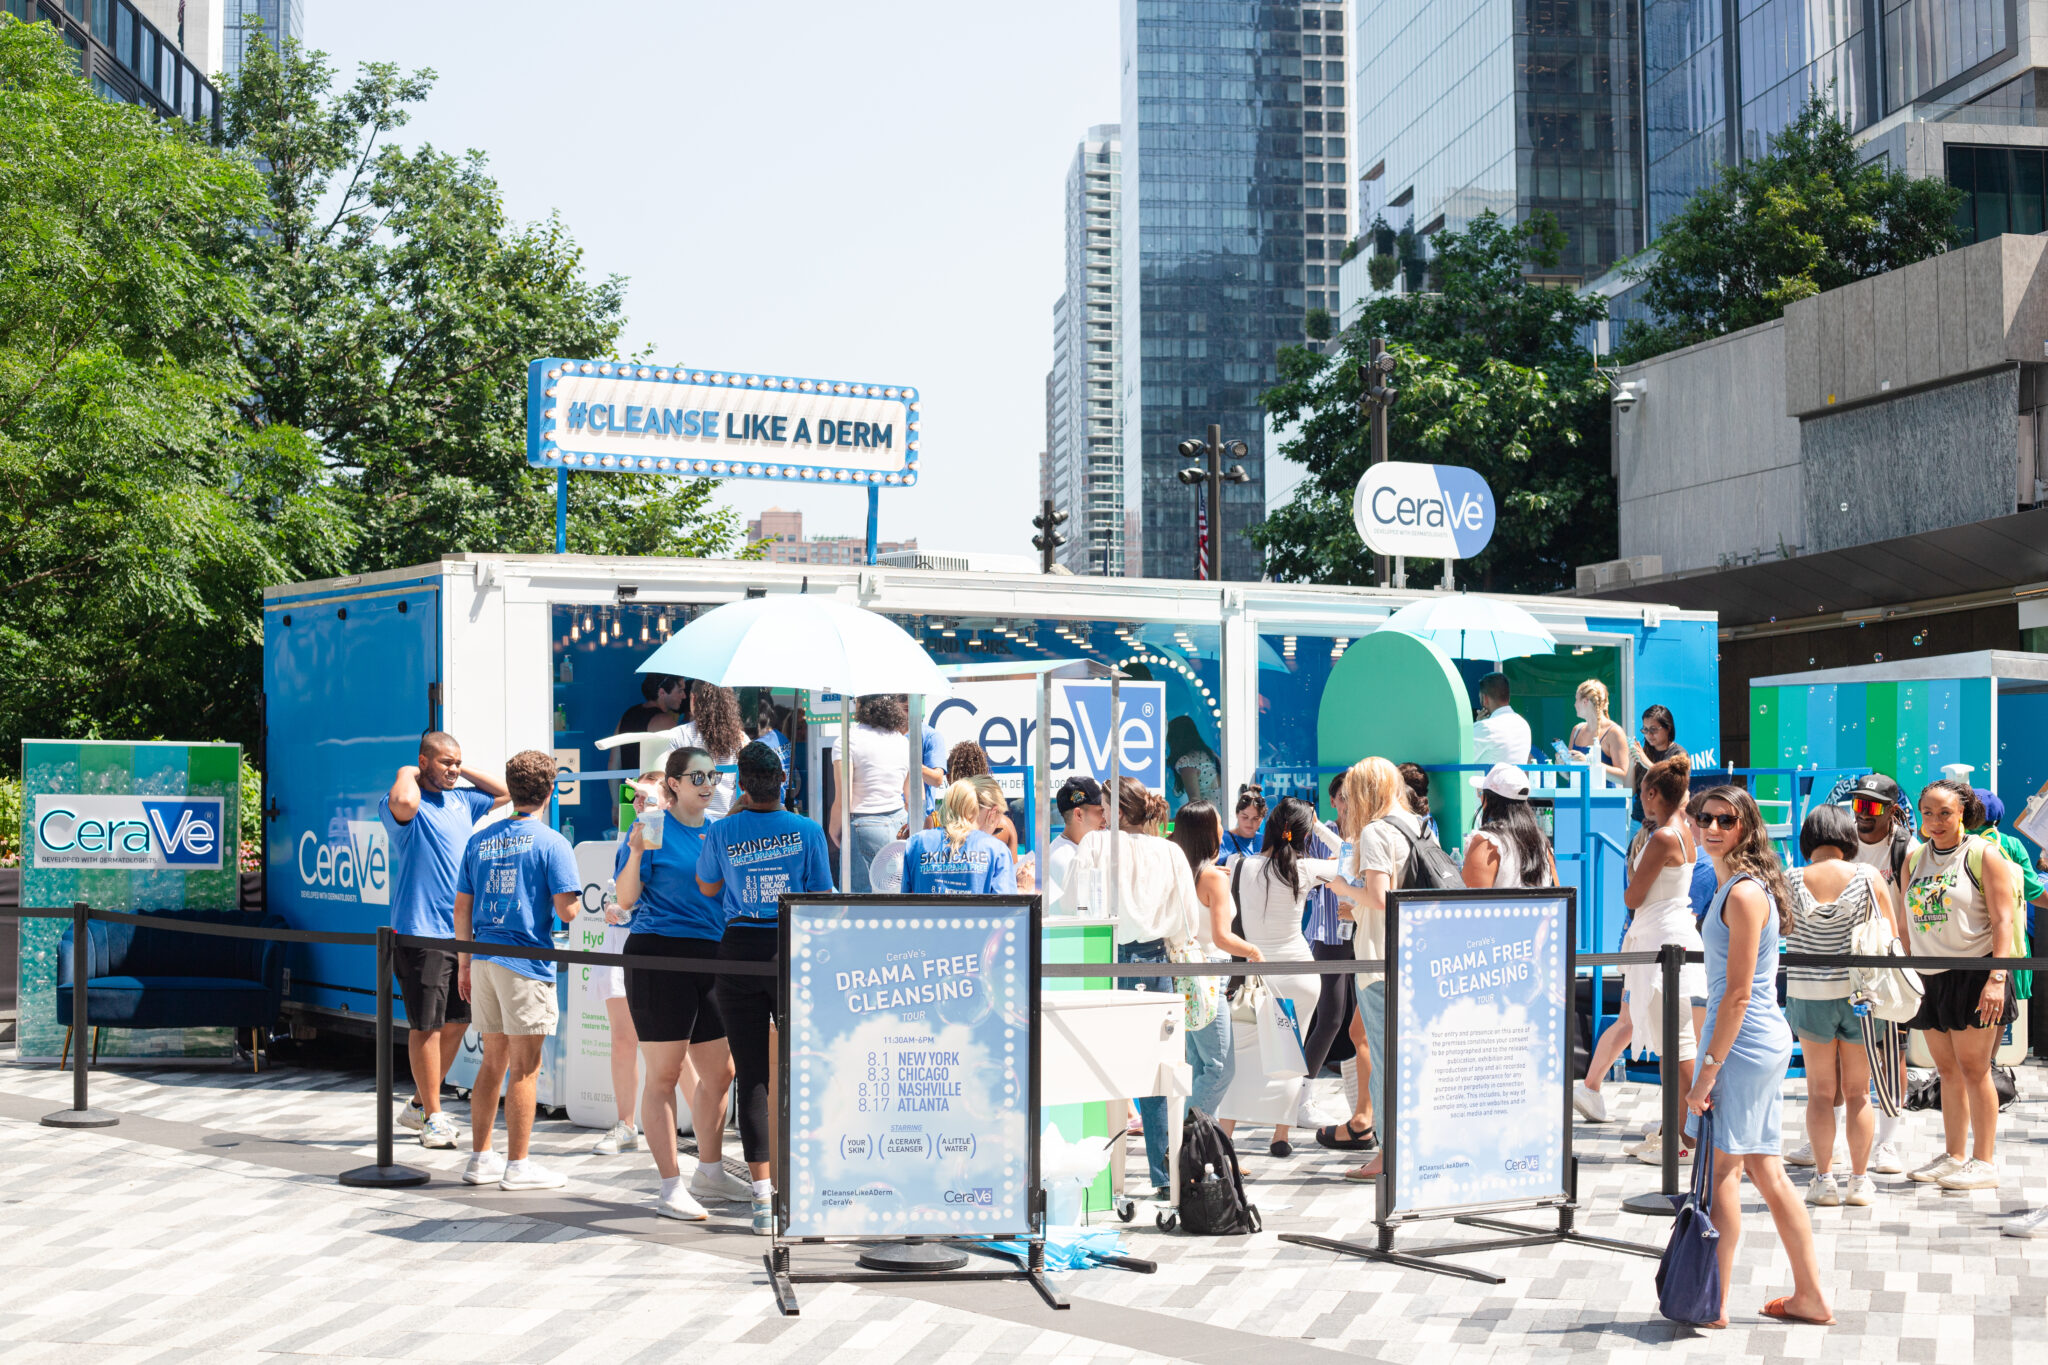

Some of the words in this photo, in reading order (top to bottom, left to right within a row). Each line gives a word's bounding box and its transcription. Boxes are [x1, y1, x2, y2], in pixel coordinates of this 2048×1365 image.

[567, 401, 720, 438] #CLEANSE
[727, 413, 788, 442] LIKE
[792, 417, 812, 443] A
[818, 419, 893, 448] DERM
[926, 637, 959, 654] FIND
[480, 834, 535, 852] SKINCARE
[727, 832, 803, 857] SKINCARE
[754, 849, 782, 861] DRAMA
[782, 844, 803, 855] FREE
[920, 850, 988, 866] SKINCARE
[745, 875, 757, 883] 8.1
[760, 874, 774, 883] NEW
[774, 873, 790, 881] YORK
[760, 881, 786, 890] CHICAGO
[1466, 936, 1496, 949] CeraVe's
[886, 949, 926, 962] CeraVe's
[1430, 950, 1488, 977] DRAMA
[1492, 939, 1533, 964] FREE
[836, 964, 916, 991] DRAMA
[923, 953, 980, 979] FREE
[1439, 963, 1528, 998] CLEANSING
[848, 979, 974, 1013] CLEANSING
[1478, 993, 1495, 1004] TOUR
[901, 1011, 926, 1022] TOUR
[883, 1036, 935, 1044] 11:30AM-6PM
[867, 1052, 888, 1066] 8.1
[898, 1052, 927, 1066] NEW
[929, 1052, 960, 1066] YORK
[867, 1067, 890, 1081] 8.3
[898, 1067, 949, 1081] CHICAGO
[858, 1082, 890, 1097] 8.10
[898, 1082, 962, 1096] NASHVILLE
[858, 1097, 890, 1112] 8.17
[897, 1097, 950, 1112] ATLANTA
[1487, 1098, 1509, 1106] websites
[890, 1124, 923, 1132] STARRING
[822, 1189, 893, 1197] #CleanseLikeADerm
